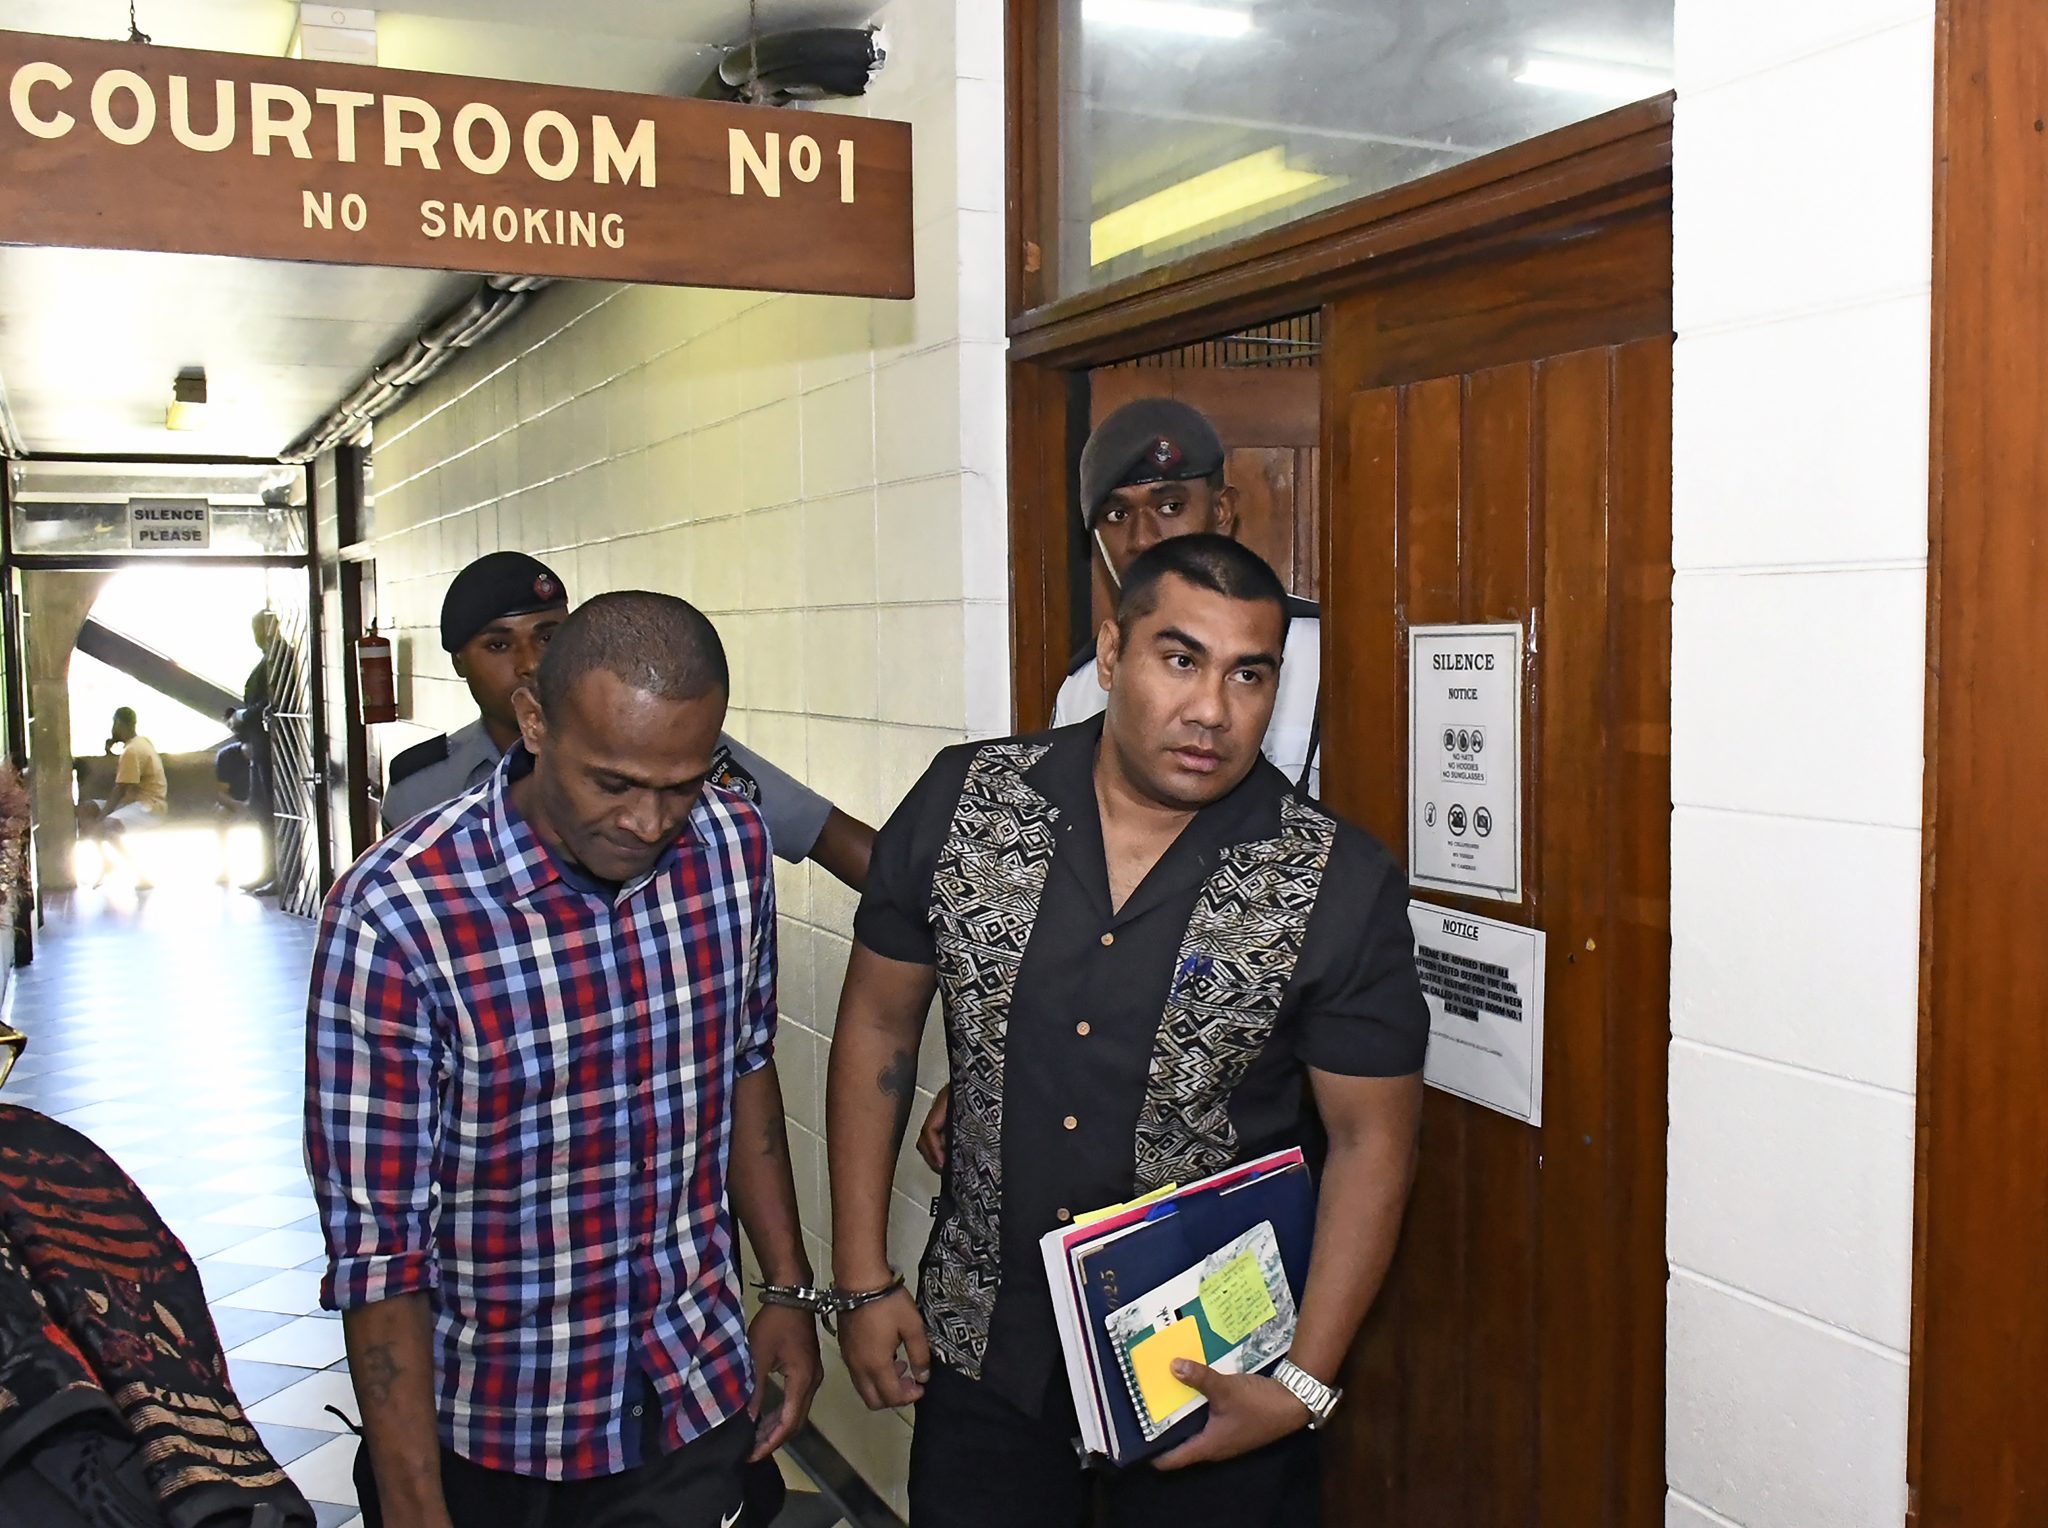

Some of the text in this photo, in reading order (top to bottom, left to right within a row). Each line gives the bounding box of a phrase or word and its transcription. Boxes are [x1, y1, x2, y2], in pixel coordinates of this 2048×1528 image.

[10, 62, 656, 188] COURTROOM
[303, 190, 624, 249] NO SMOKING
[134, 509, 204, 520] SILENCE
[140, 530, 202, 541] PLEASE
[1433, 653, 1495, 671] SILENCE
[1448, 687, 1478, 700] NOTICE
[711, 761, 729, 783] OLICE
[1443, 919, 1479, 939] NOTICE
